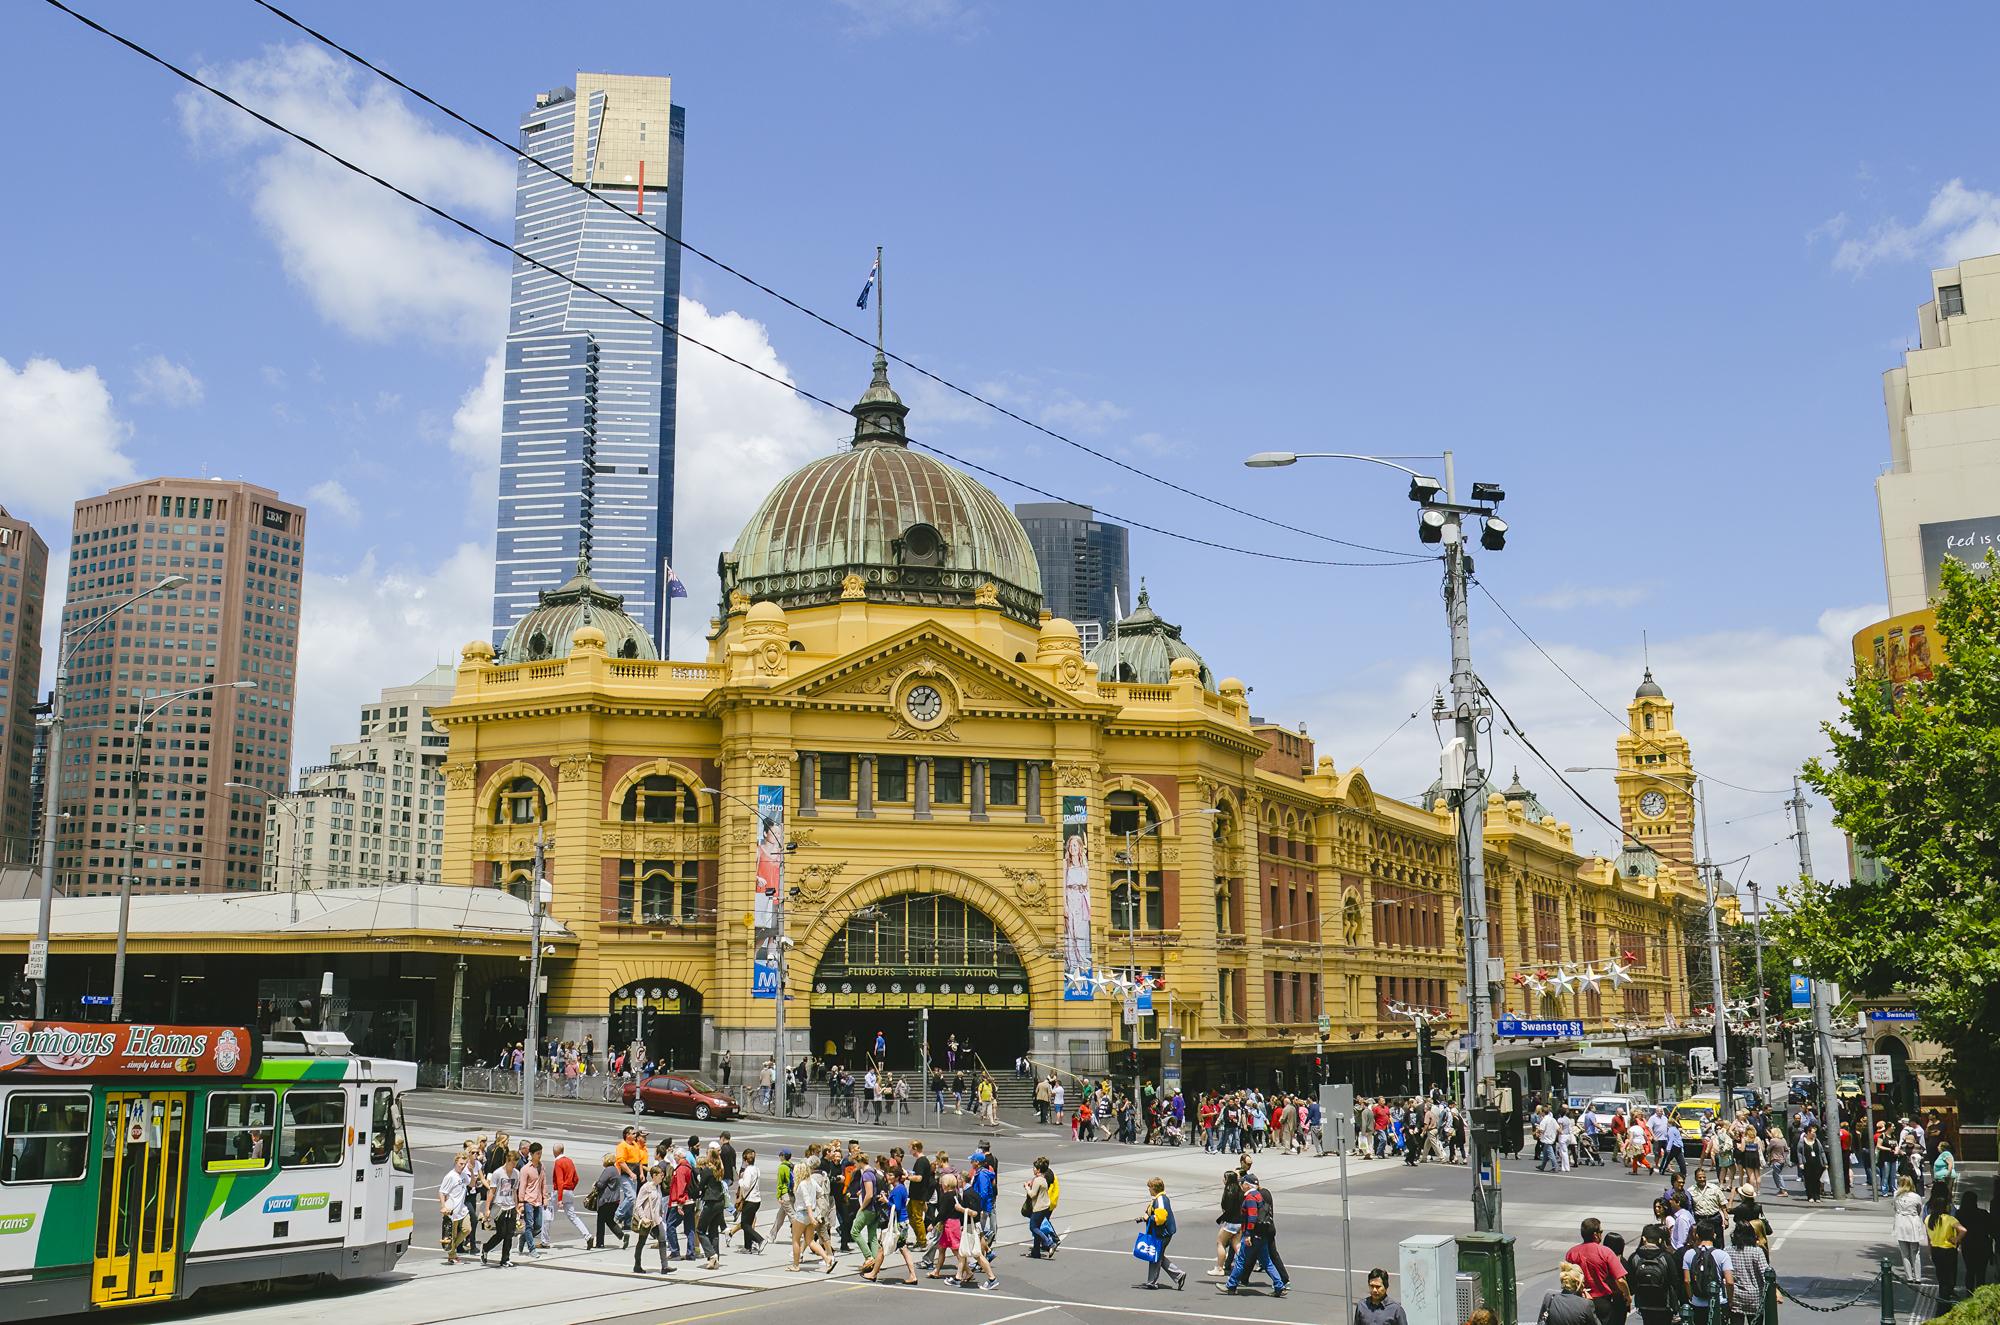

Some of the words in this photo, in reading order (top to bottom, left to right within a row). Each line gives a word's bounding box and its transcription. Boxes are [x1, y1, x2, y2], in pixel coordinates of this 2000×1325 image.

[266, 510, 283, 523] IBM
[1947, 531, 1976, 549] Red
[759, 794, 772, 803] my
[759, 804, 784, 812] metro
[1074, 805, 1086, 814] my
[1063, 814, 1087, 822] metro
[848, 967, 896, 976] FLINDERS
[907, 968, 942, 977] STREET
[954, 968, 998, 977] STATION
[1521, 1021, 1568, 1031] Swanston
[1570, 1021, 1581, 1031] St
[0, 1022, 116, 1057] Famous
[121, 1025, 208, 1057] Hams
[127, 1060, 149, 1072] simply
[150, 1060, 160, 1069] the
[160, 1060, 173, 1069] best
[267, 1198, 291, 1211] yarra
[300, 1195, 325, 1206] trams
